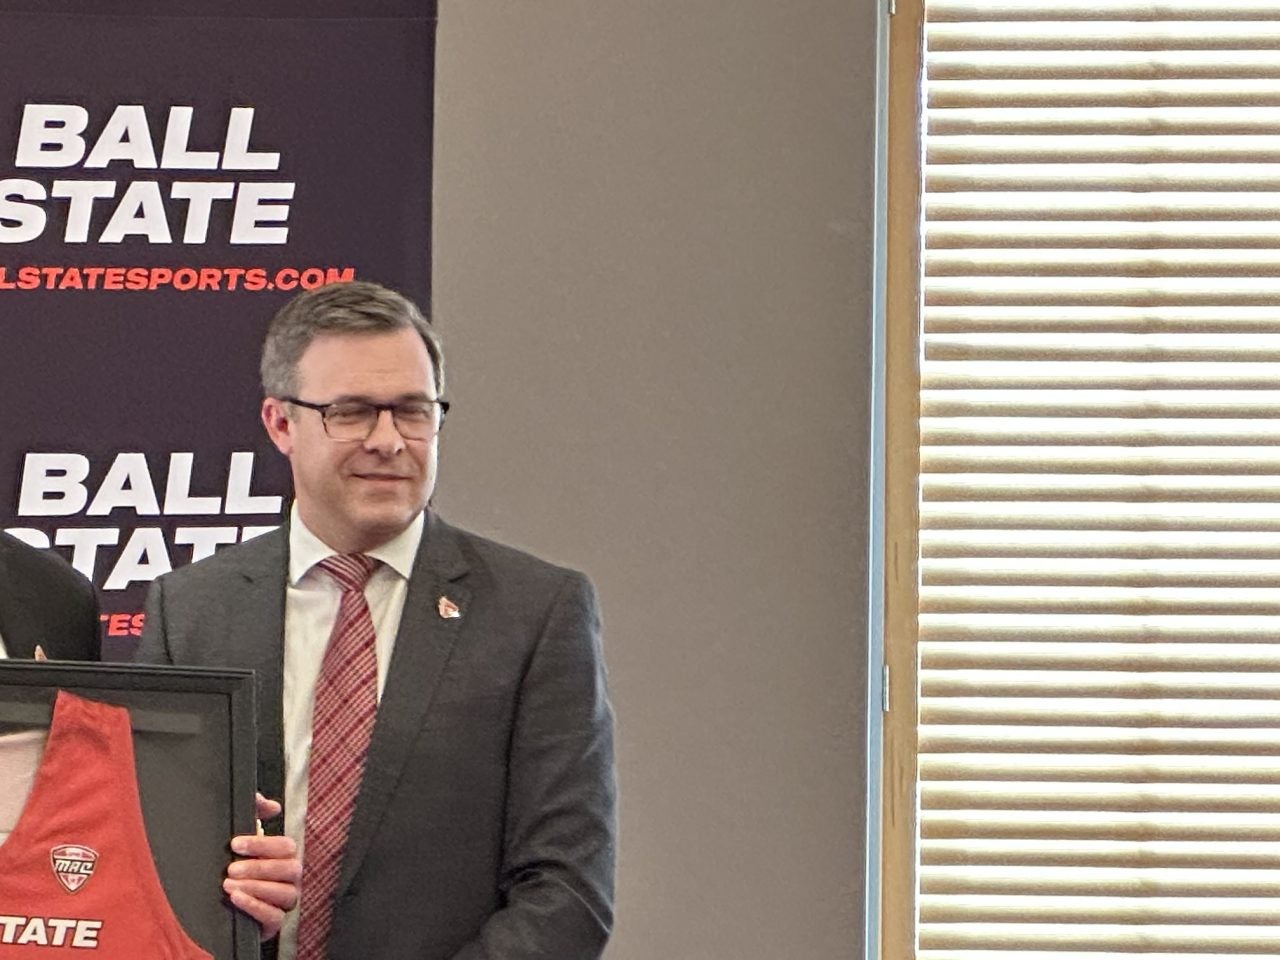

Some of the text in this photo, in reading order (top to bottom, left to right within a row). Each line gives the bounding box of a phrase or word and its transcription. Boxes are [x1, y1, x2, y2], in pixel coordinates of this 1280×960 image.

[15, 103, 281, 170] BALL
[18, 451, 283, 516] BALL
[55, 859, 94, 874] MAC
